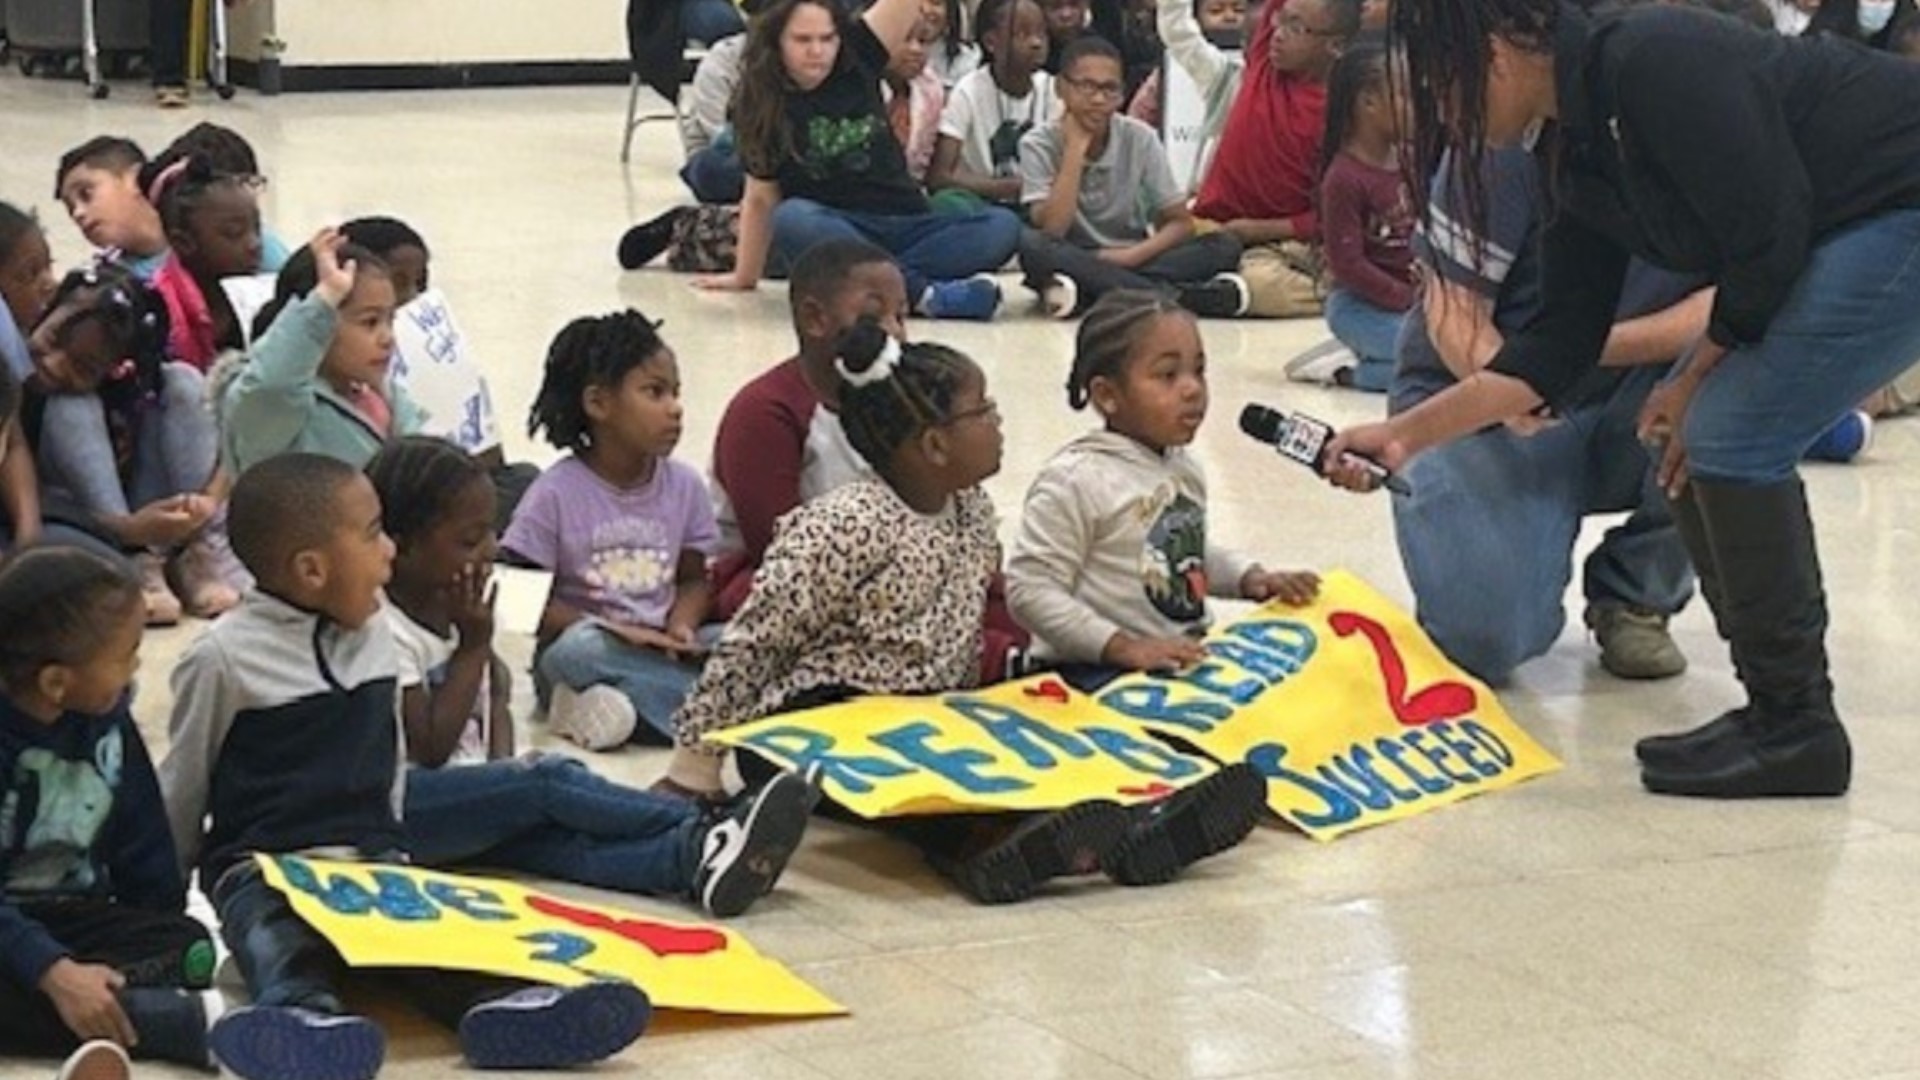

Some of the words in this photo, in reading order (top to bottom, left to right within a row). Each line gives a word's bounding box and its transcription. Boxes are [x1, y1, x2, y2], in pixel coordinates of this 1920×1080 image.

[1098, 619, 1317, 733] READ
[1328, 611, 1478, 725] 2
[1245, 719, 1514, 828] SUCCEED
